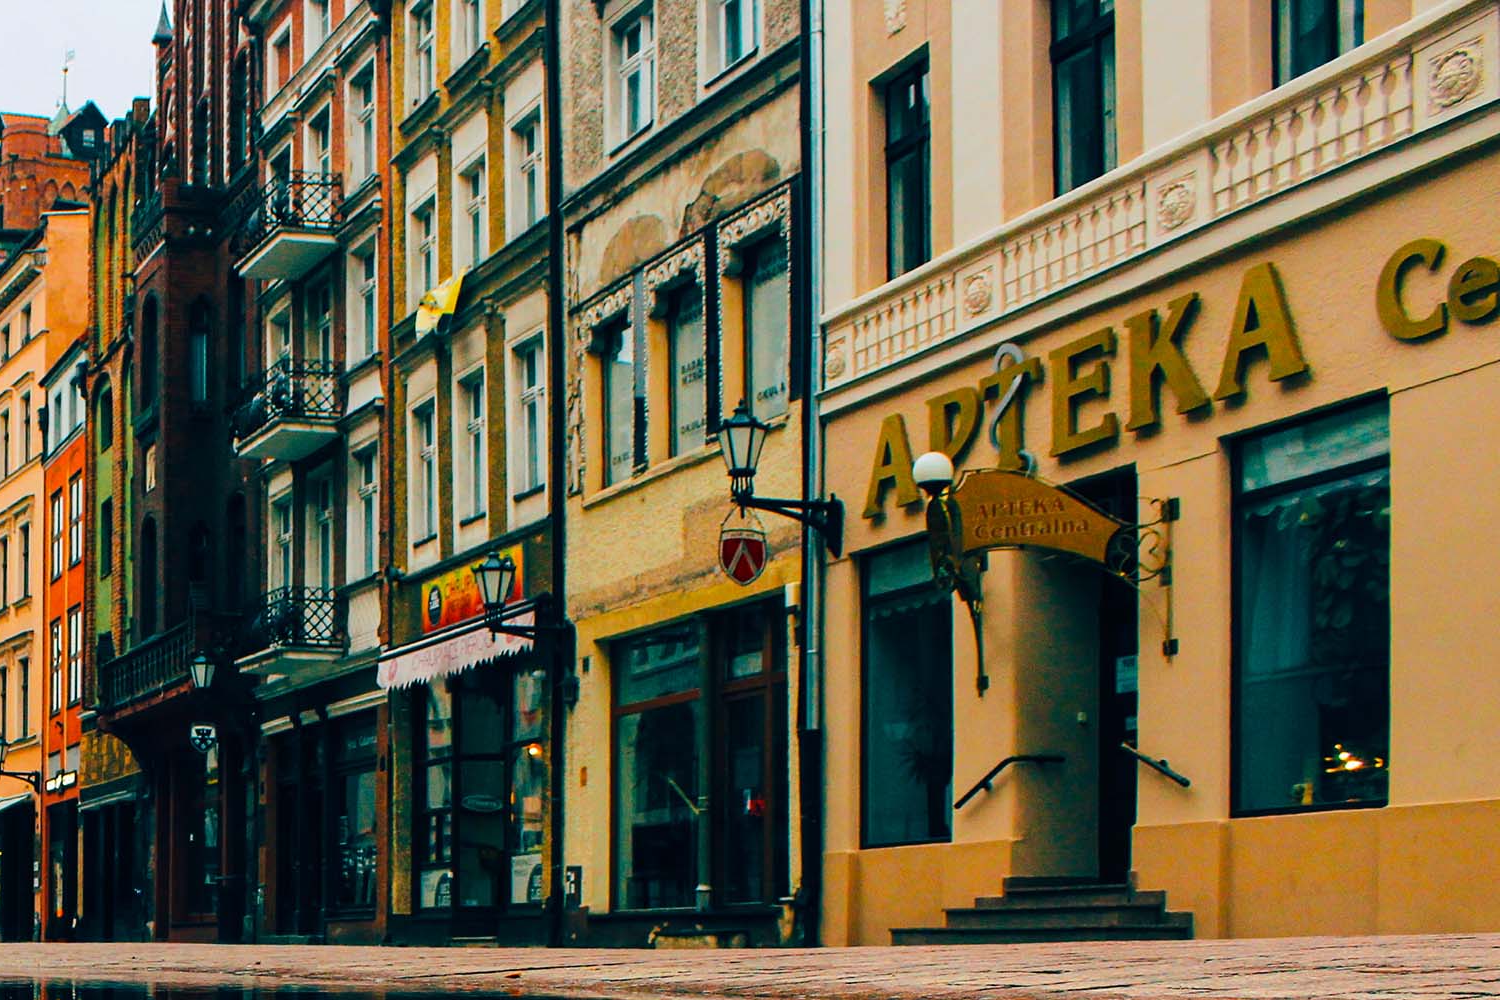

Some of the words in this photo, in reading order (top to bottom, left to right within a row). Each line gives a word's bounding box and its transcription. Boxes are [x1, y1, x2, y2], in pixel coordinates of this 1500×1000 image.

[862, 261, 1308, 519] APTEKA
[978, 497, 1065, 519] APTEKA
[974, 518, 1089, 540] Centralna
